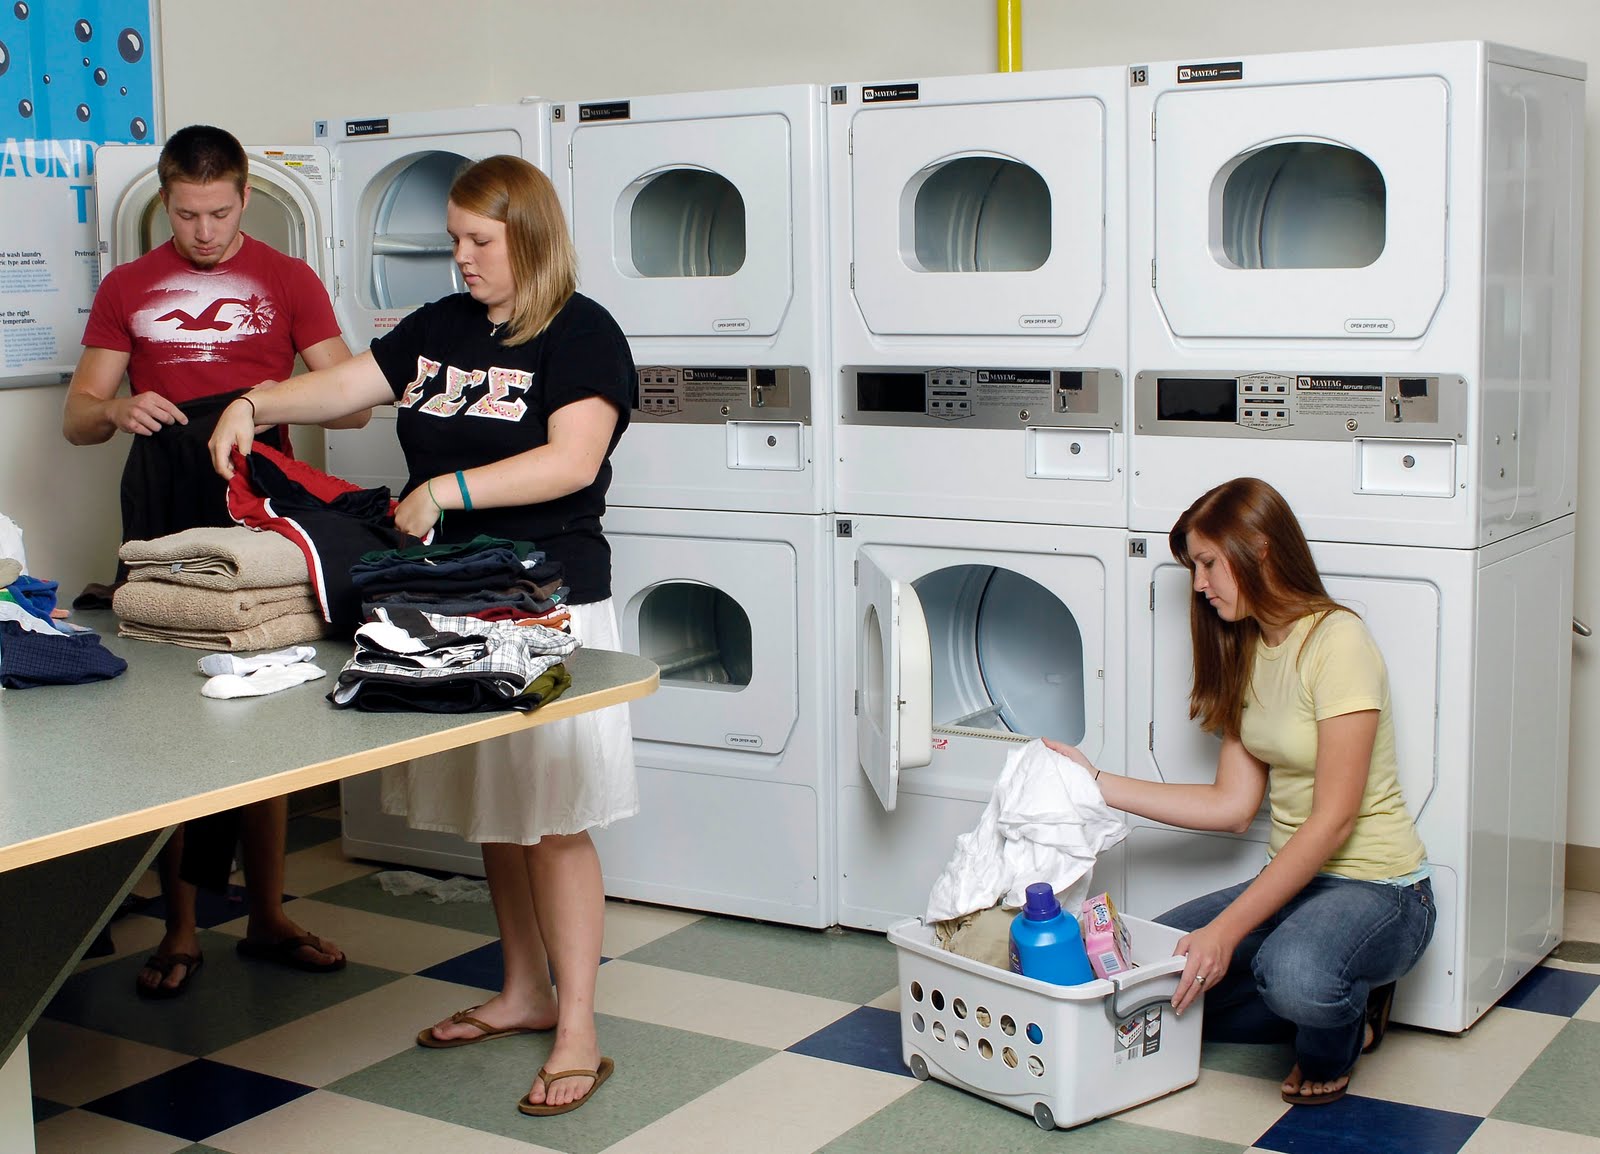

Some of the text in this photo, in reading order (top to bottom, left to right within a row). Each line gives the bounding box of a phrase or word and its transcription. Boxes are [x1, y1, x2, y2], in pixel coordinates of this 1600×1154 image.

[1132, 70, 1146, 83] 13
[1191, 69, 1218, 78] MAYTAG
[833, 89, 844, 101] 11
[555, 108, 561, 119] 9
[319, 124, 324, 135] 7
[838, 522, 850, 534] 12
[1132, 542, 1144, 554] 14
